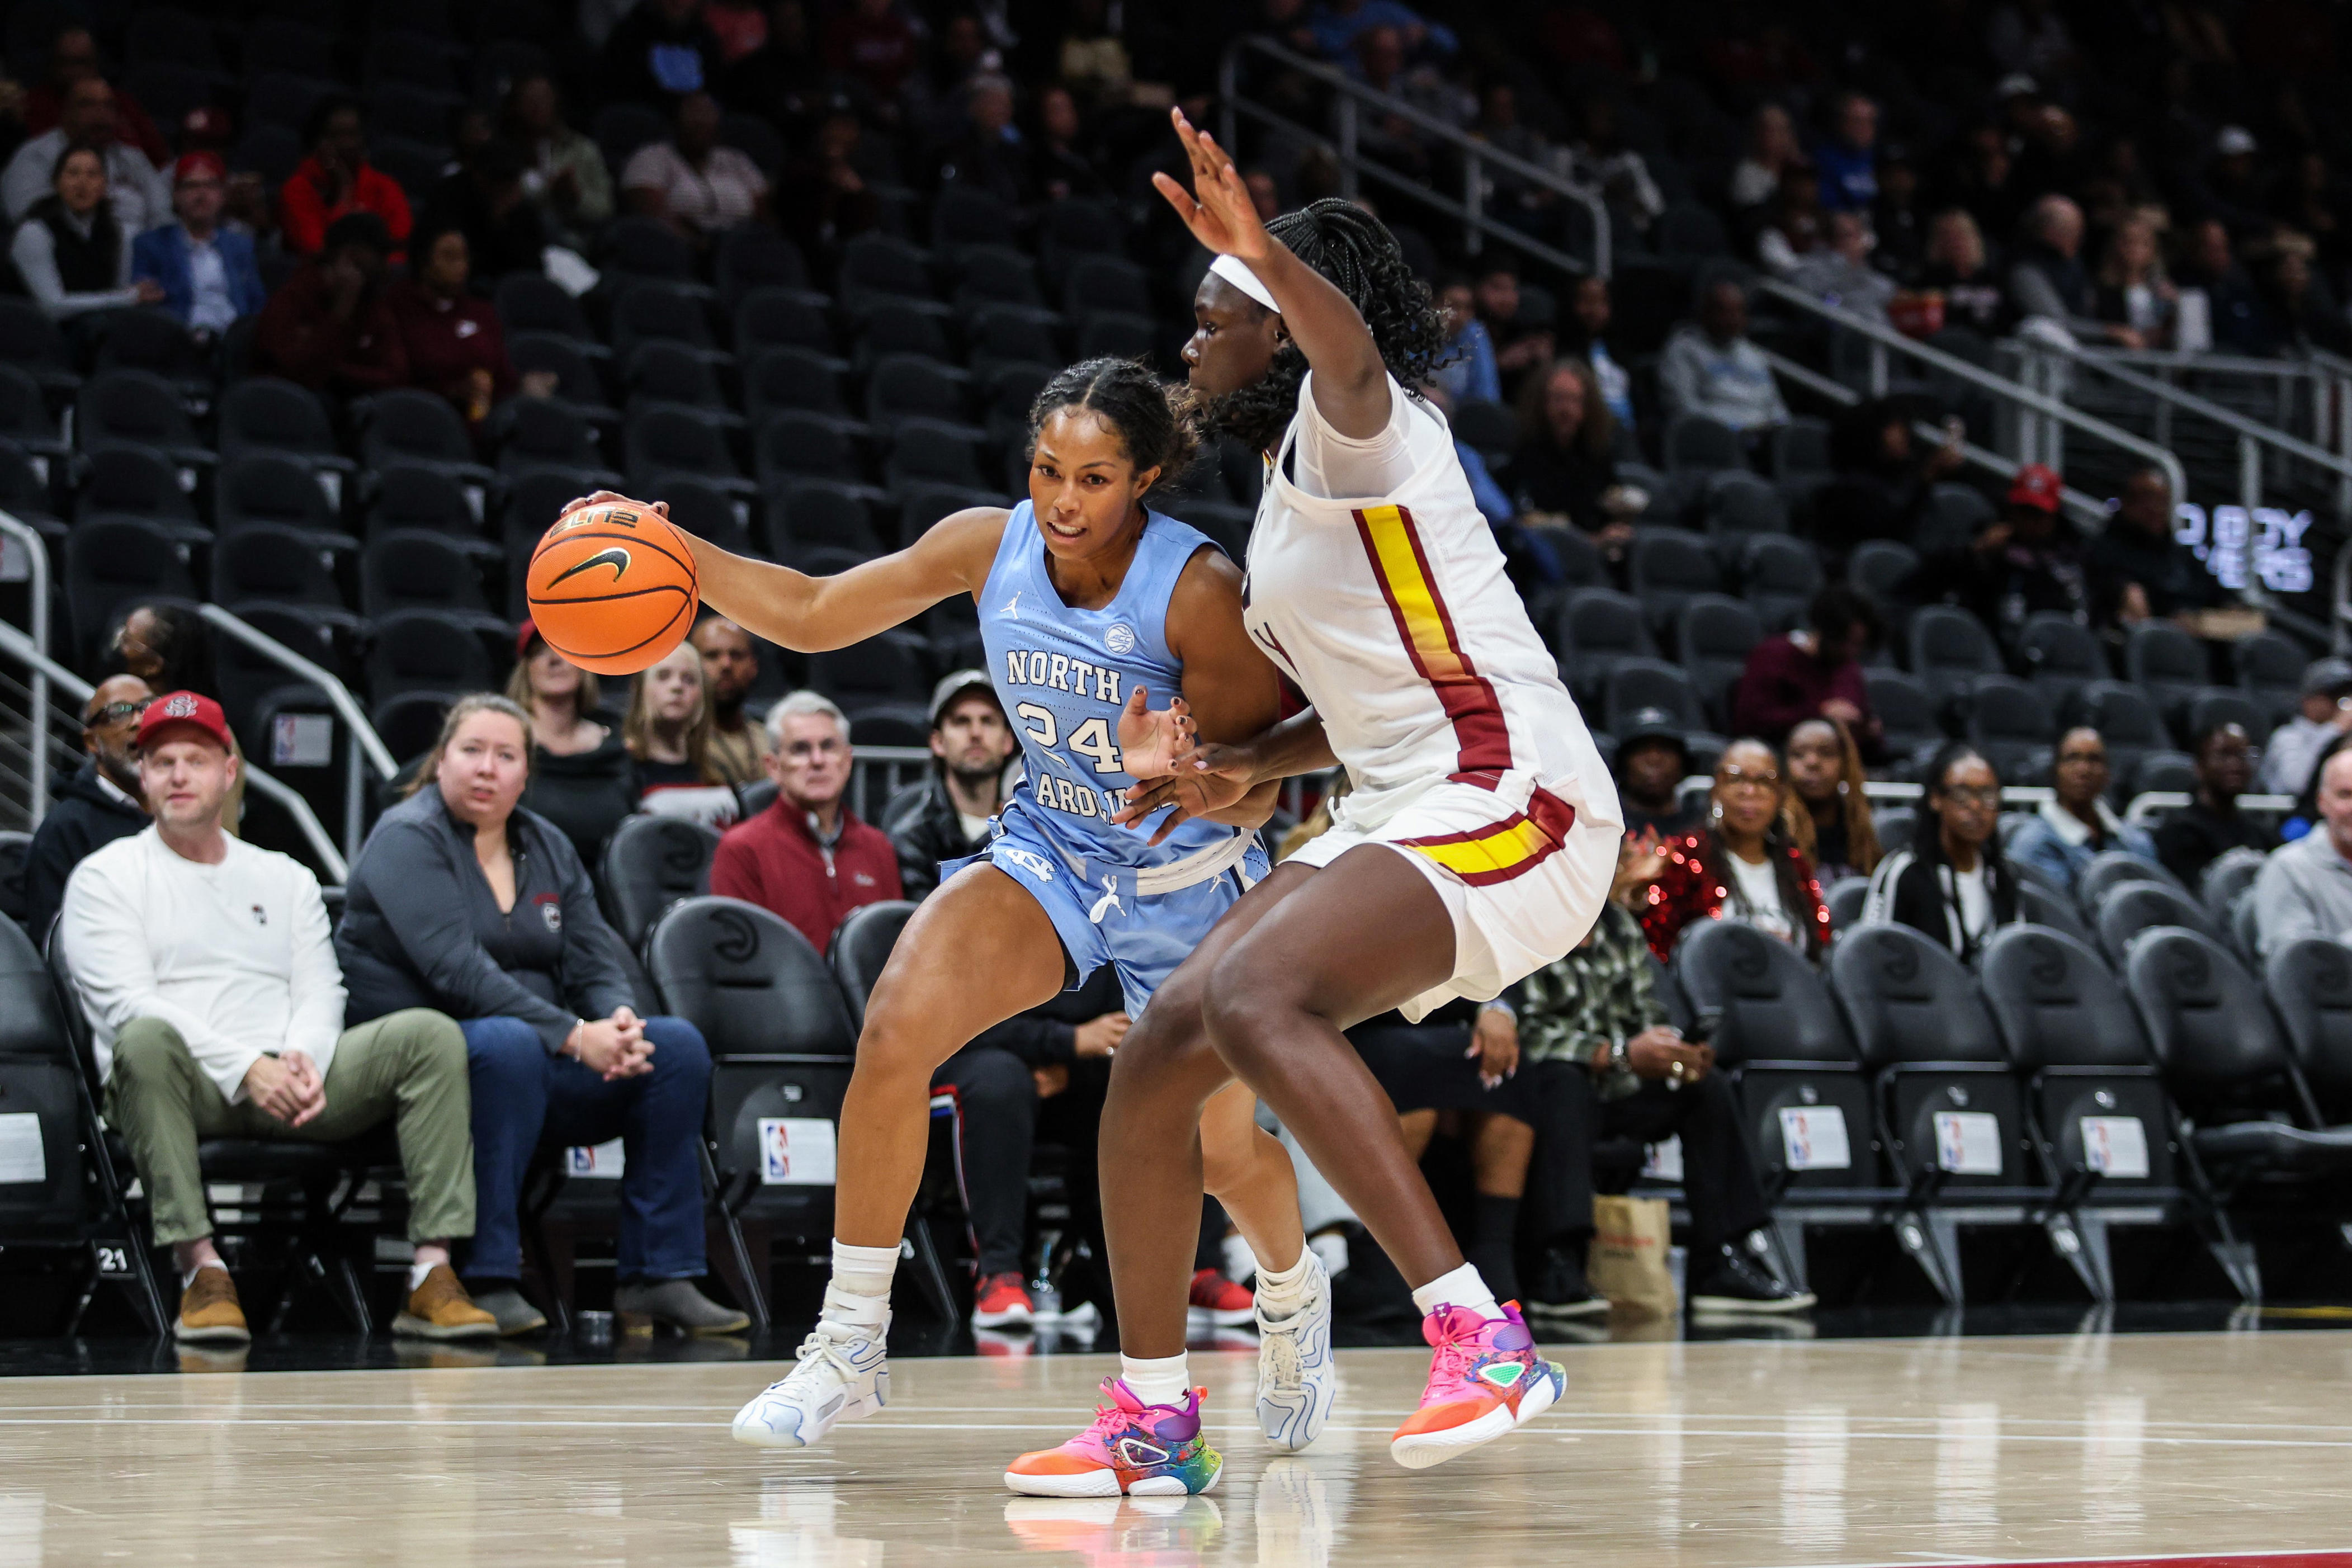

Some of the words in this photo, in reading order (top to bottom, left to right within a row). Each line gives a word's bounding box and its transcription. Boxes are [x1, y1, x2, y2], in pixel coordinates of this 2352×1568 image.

[1007, 650, 1122, 706] NORTH
[1016, 701, 1125, 774] 24
[97, 1246, 127, 1271] 21
